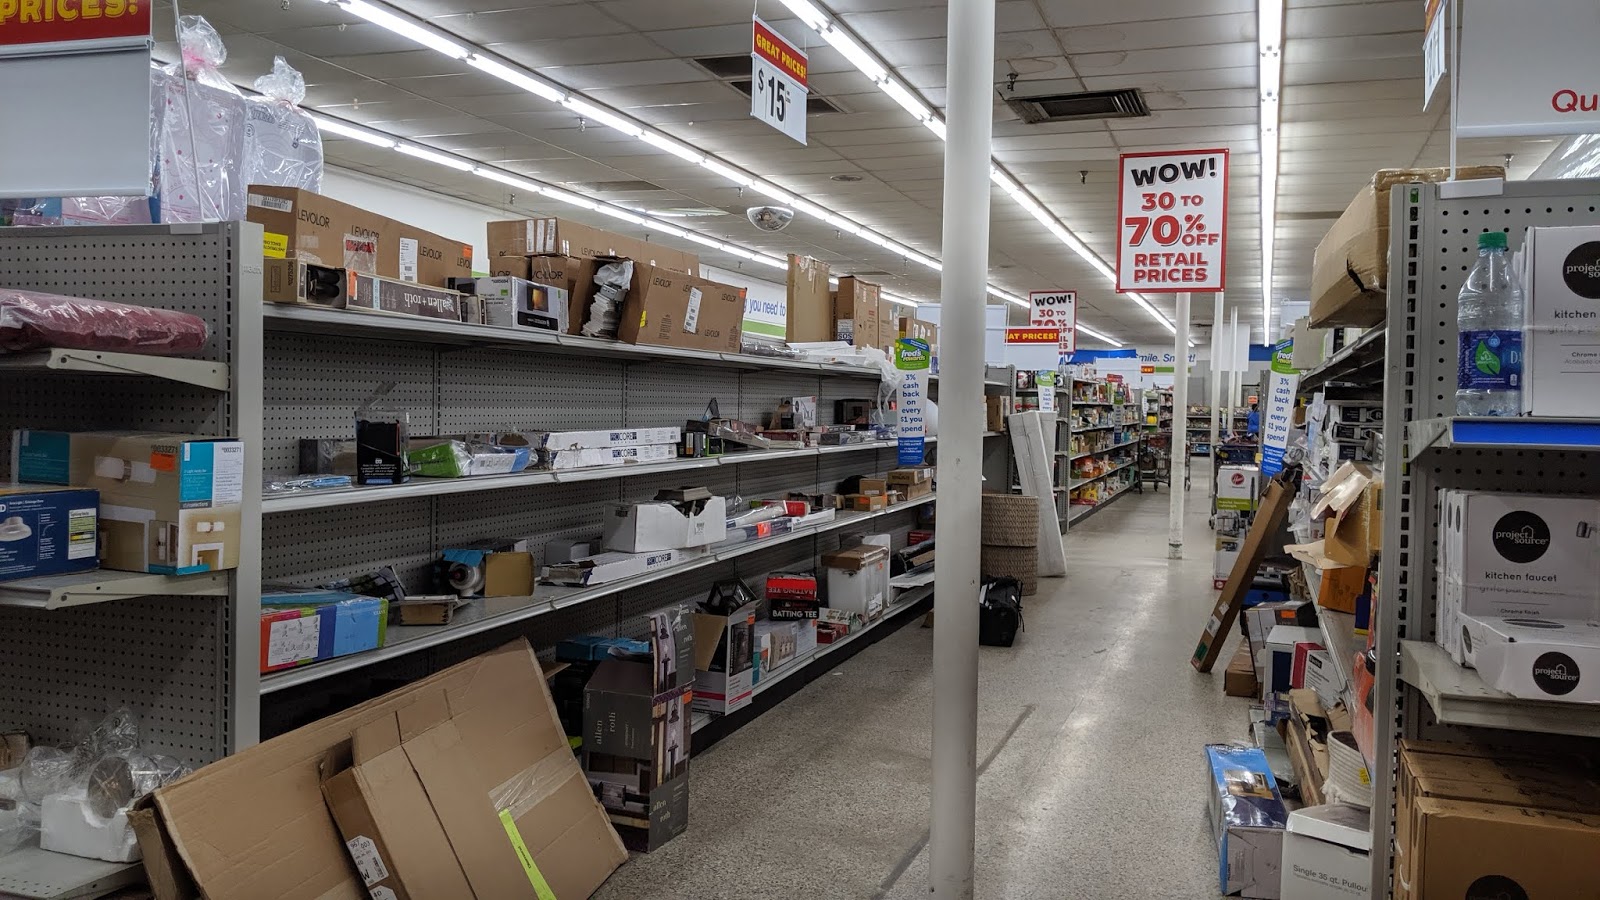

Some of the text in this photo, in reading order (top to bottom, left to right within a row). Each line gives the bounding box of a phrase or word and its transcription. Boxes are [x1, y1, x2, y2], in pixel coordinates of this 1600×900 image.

[756, 34, 806, 79] GREAT PRICES!
[768, 76, 785, 122] 15
[1131, 158, 1216, 186] WOW!
[1141, 192, 1204, 211] 30 TO
[298, 208, 330, 229] LEVOLOR
[1182, 234, 1218, 246] OFF
[420, 246, 442, 260] LEVOLOR
[1134, 252, 1208, 268] RETAIL
[1134, 268, 1208, 283] PRICES
[653, 278, 672, 288] LEVOLOR
[1035, 294, 1072, 306] WOW!
[749, 299, 785, 316] you need to
[1039, 309, 1054, 317] 30
[1554, 310, 1596, 318] kitchen
[902, 349, 921, 358] fred's
[1274, 396, 1289, 404] back
[1271, 414, 1287, 423] every
[901, 425, 922, 433] spend
[1267, 433, 1285, 442] spend
[1496, 531, 1529, 540] project
[1485, 572, 1557, 582] kitchen faucet
[1293, 864, 1317, 877] Single
[1319, 872, 1328, 880] 35
[1342, 879, 1368, 892] Pullou
